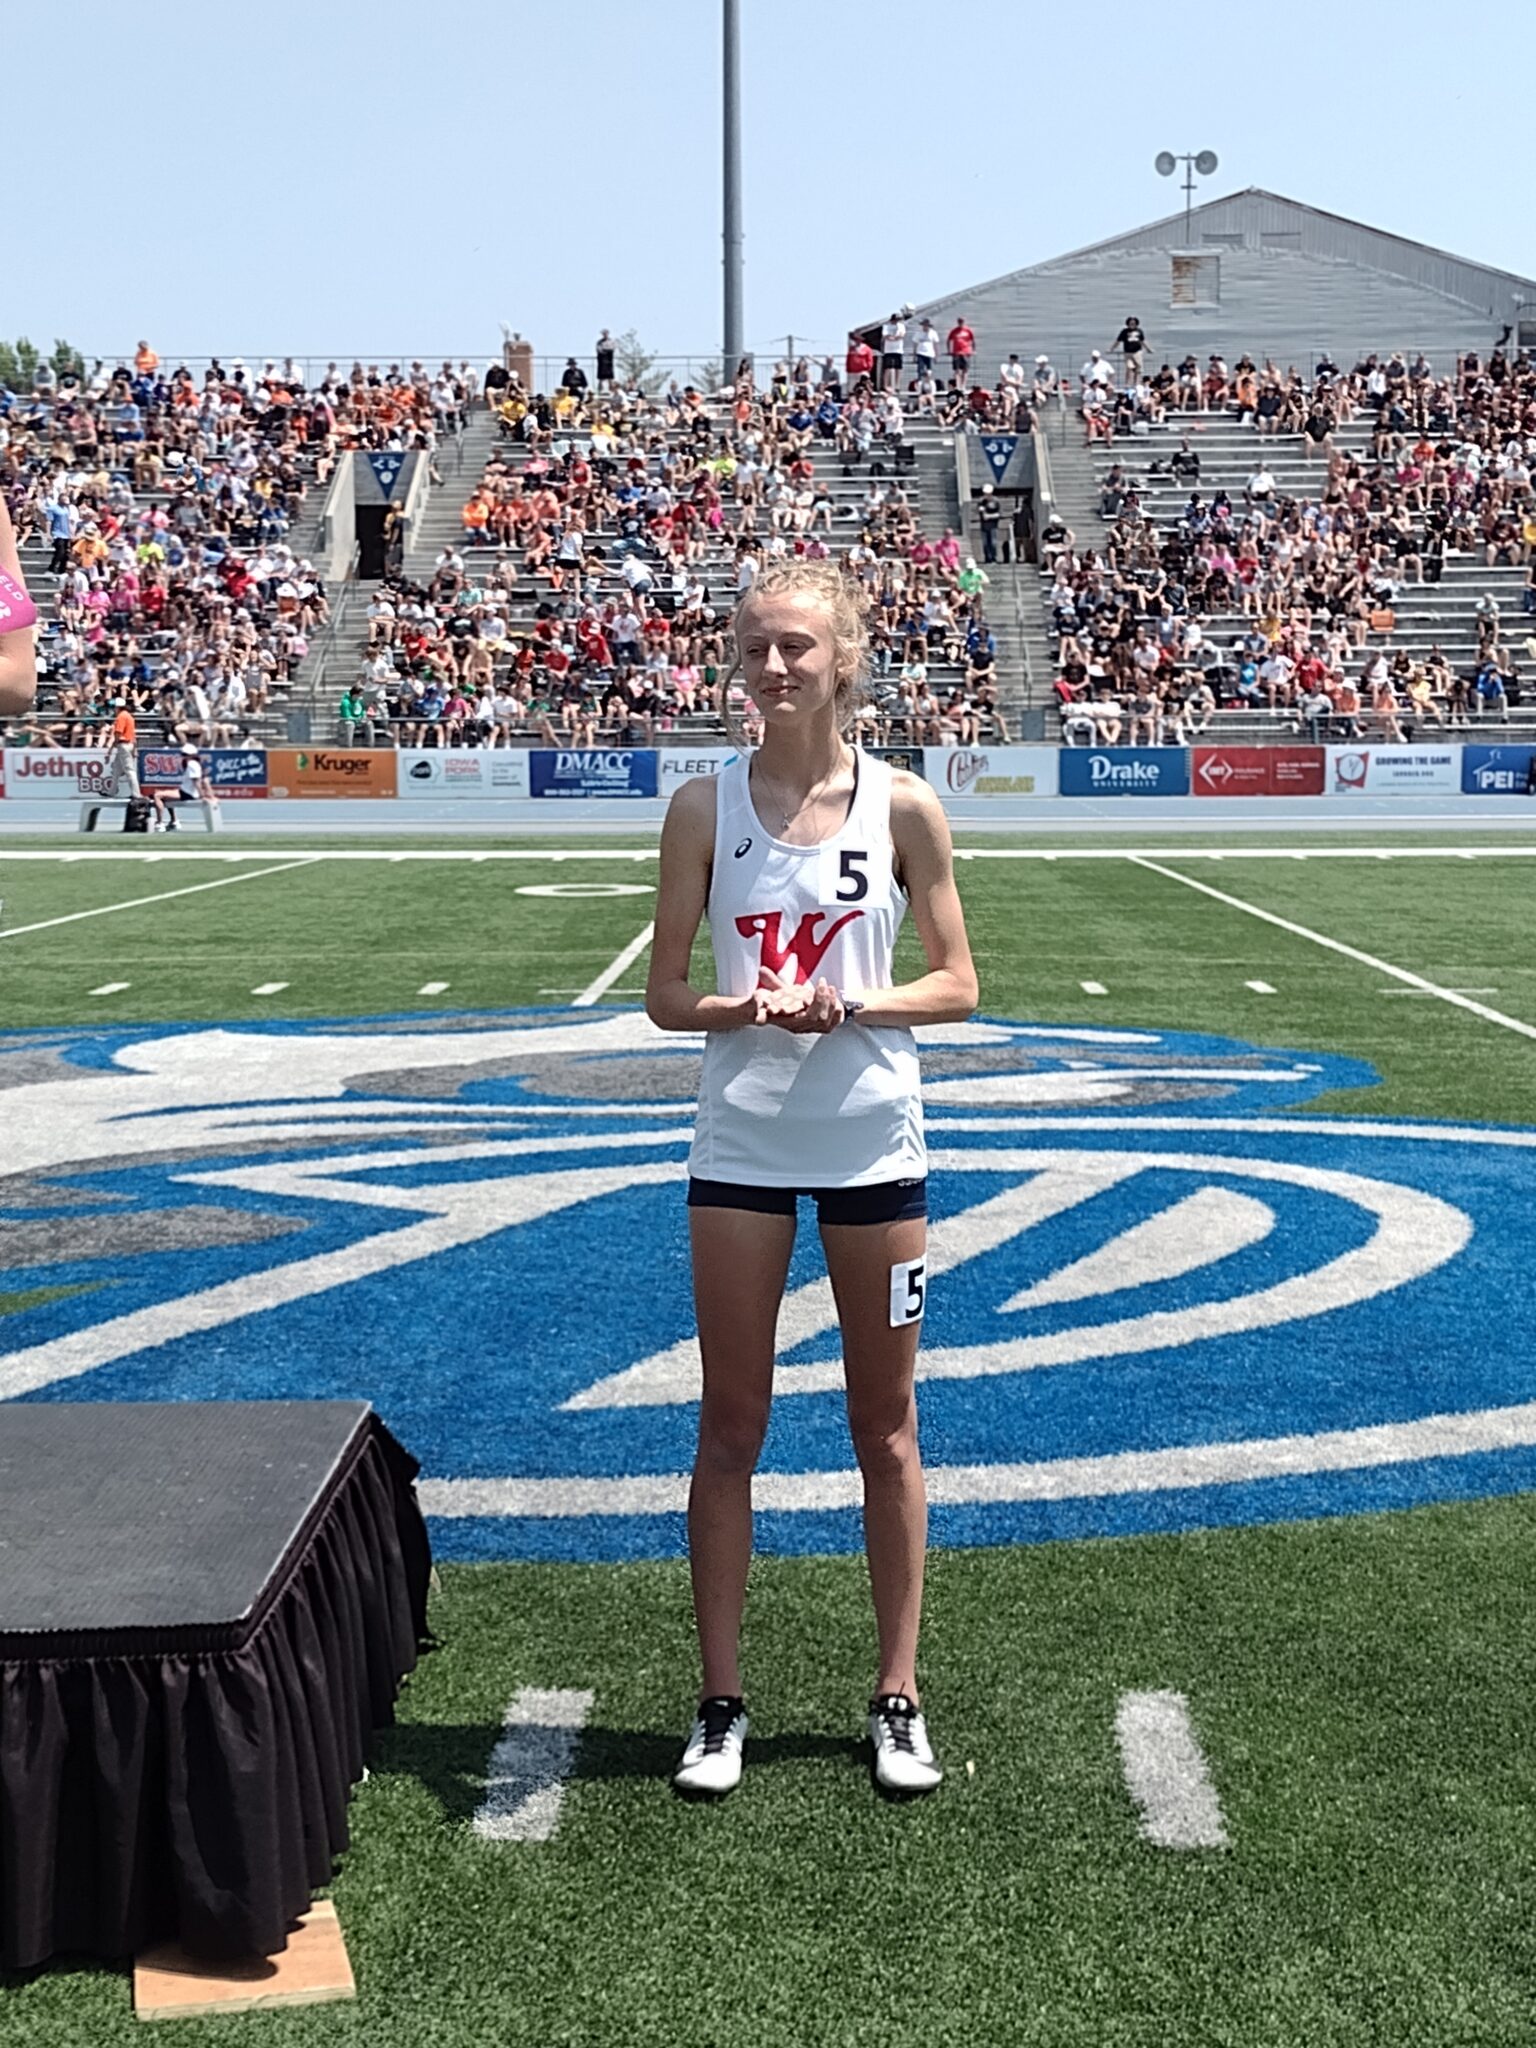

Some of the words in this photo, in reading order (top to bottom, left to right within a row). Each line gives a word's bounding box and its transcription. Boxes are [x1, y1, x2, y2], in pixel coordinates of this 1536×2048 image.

[16, 755, 110, 777] Jethro'
[314, 754, 371, 775] Kruger
[445, 758, 480, 766] IOWA
[556, 752, 633, 771] DMACC
[662, 760, 719, 773] FLEET
[1088, 755, 1160, 780] Drake
[1376, 756, 1412, 765] GROWING
[1415, 756, 1428, 765] THE
[1430, 756, 1451, 765] GAME
[445, 767, 480, 775] PORK
[1481, 770, 1514, 789] PEI
[836, 850, 869, 902] 5
[735, 909, 866, 989] W
[905, 1265, 925, 1319] 5
